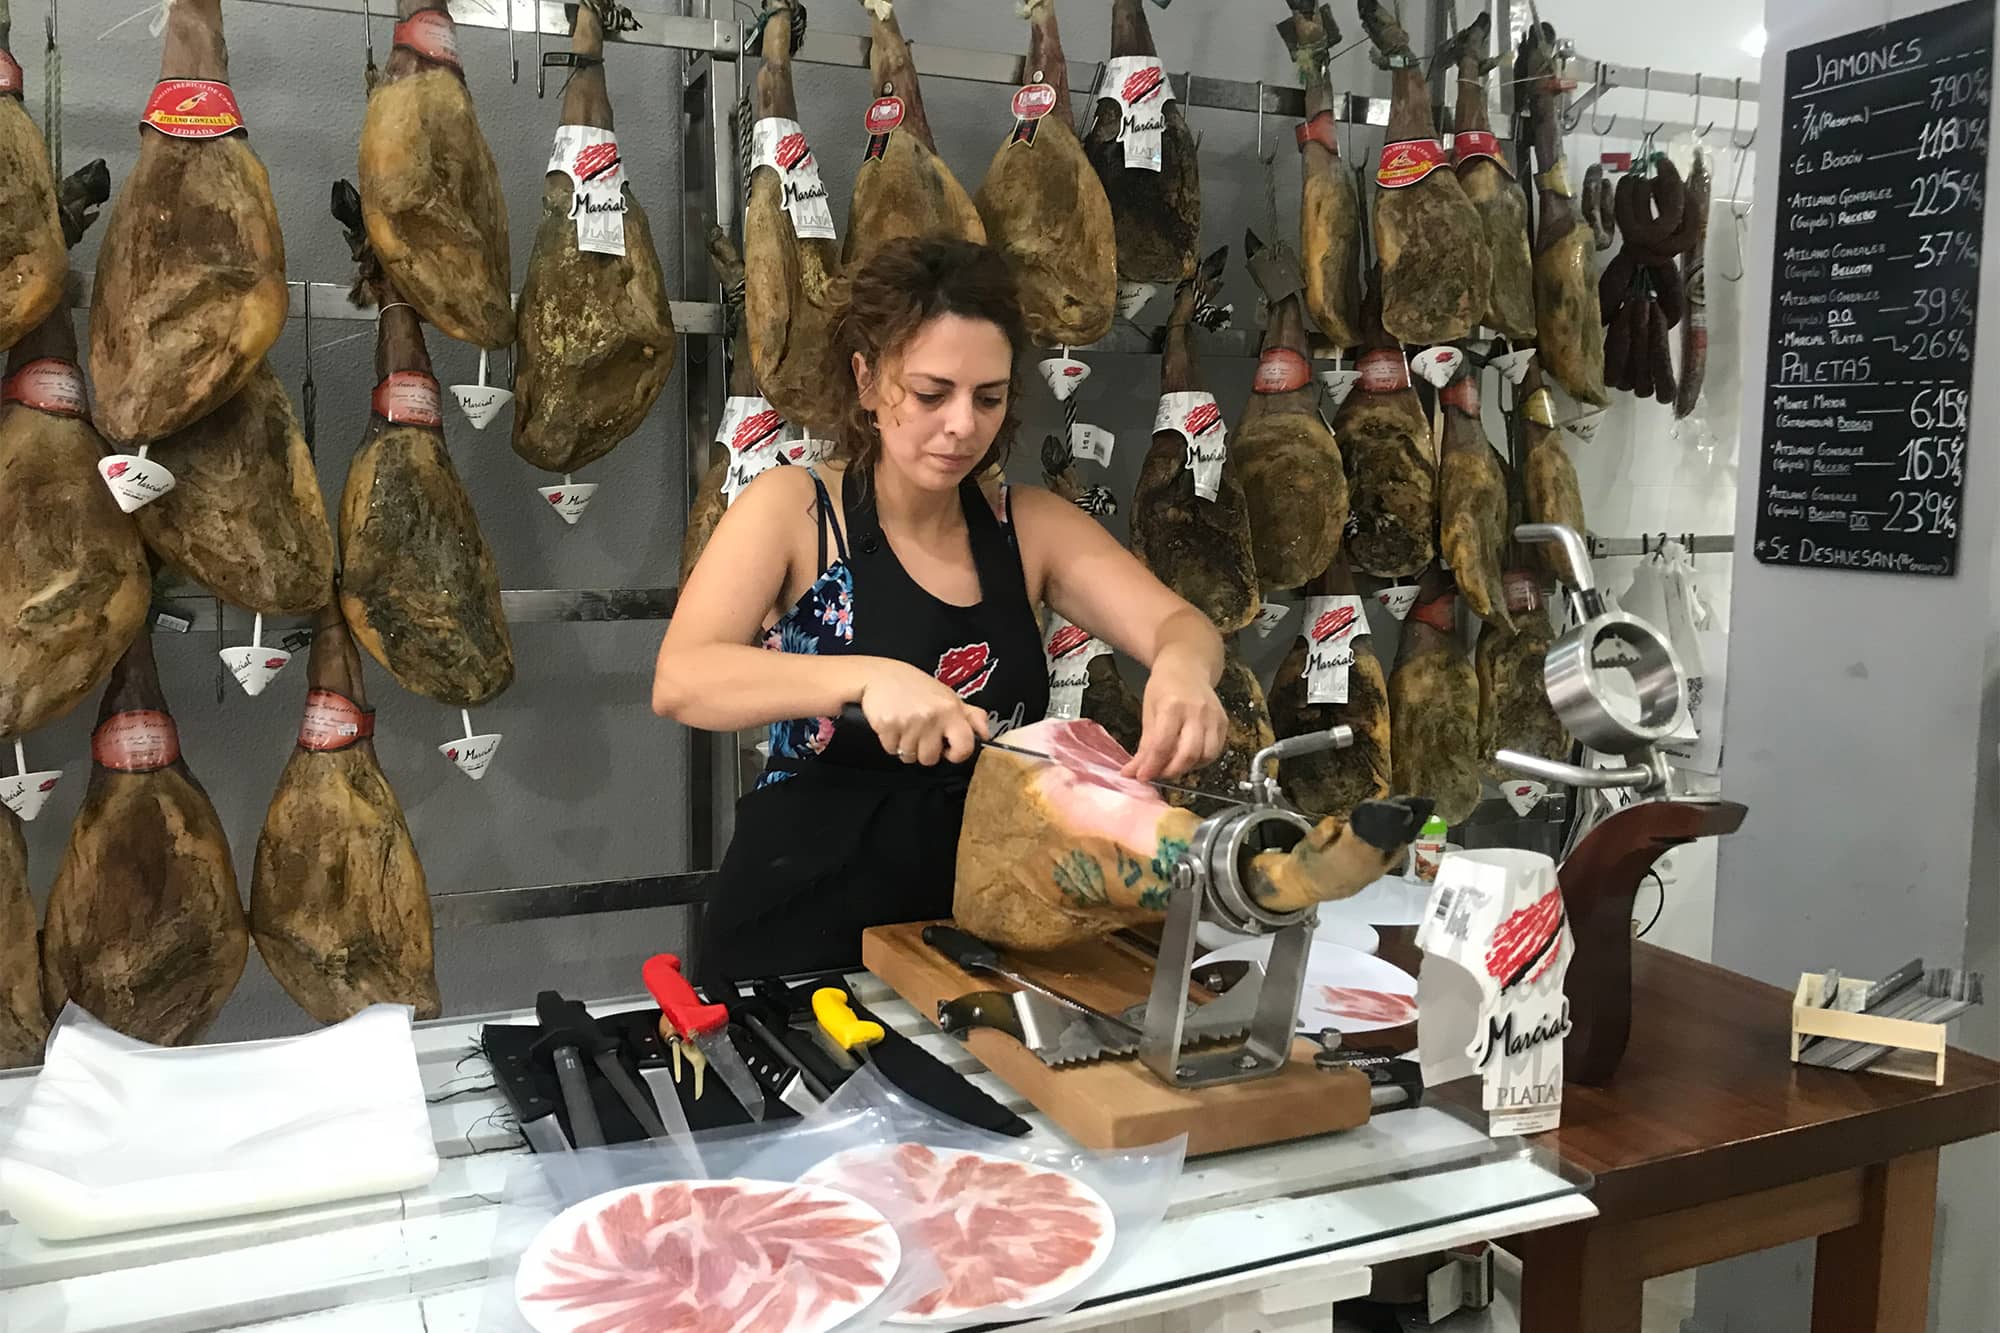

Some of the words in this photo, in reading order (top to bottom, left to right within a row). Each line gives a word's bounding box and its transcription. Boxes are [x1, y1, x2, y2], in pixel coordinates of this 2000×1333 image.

[1801, 38, 1922, 90] JAMONES
[1119, 115, 1164, 137] Marcial
[1795, 154, 1814, 175] EL
[572, 193, 626, 217] Marcial
[783, 182, 827, 207] Marcial
[1780, 352, 1871, 383] PALETAS
[462, 396, 493, 408] Marcial
[1187, 445, 1226, 466] Marcial
[127, 472, 169, 493] Marcial
[1765, 536, 1790, 560] SE
[1305, 651, 1353, 677] Marcial
[1474, 1002, 1569, 1069] Marcial
[1496, 1082, 1558, 1108] PLATA
